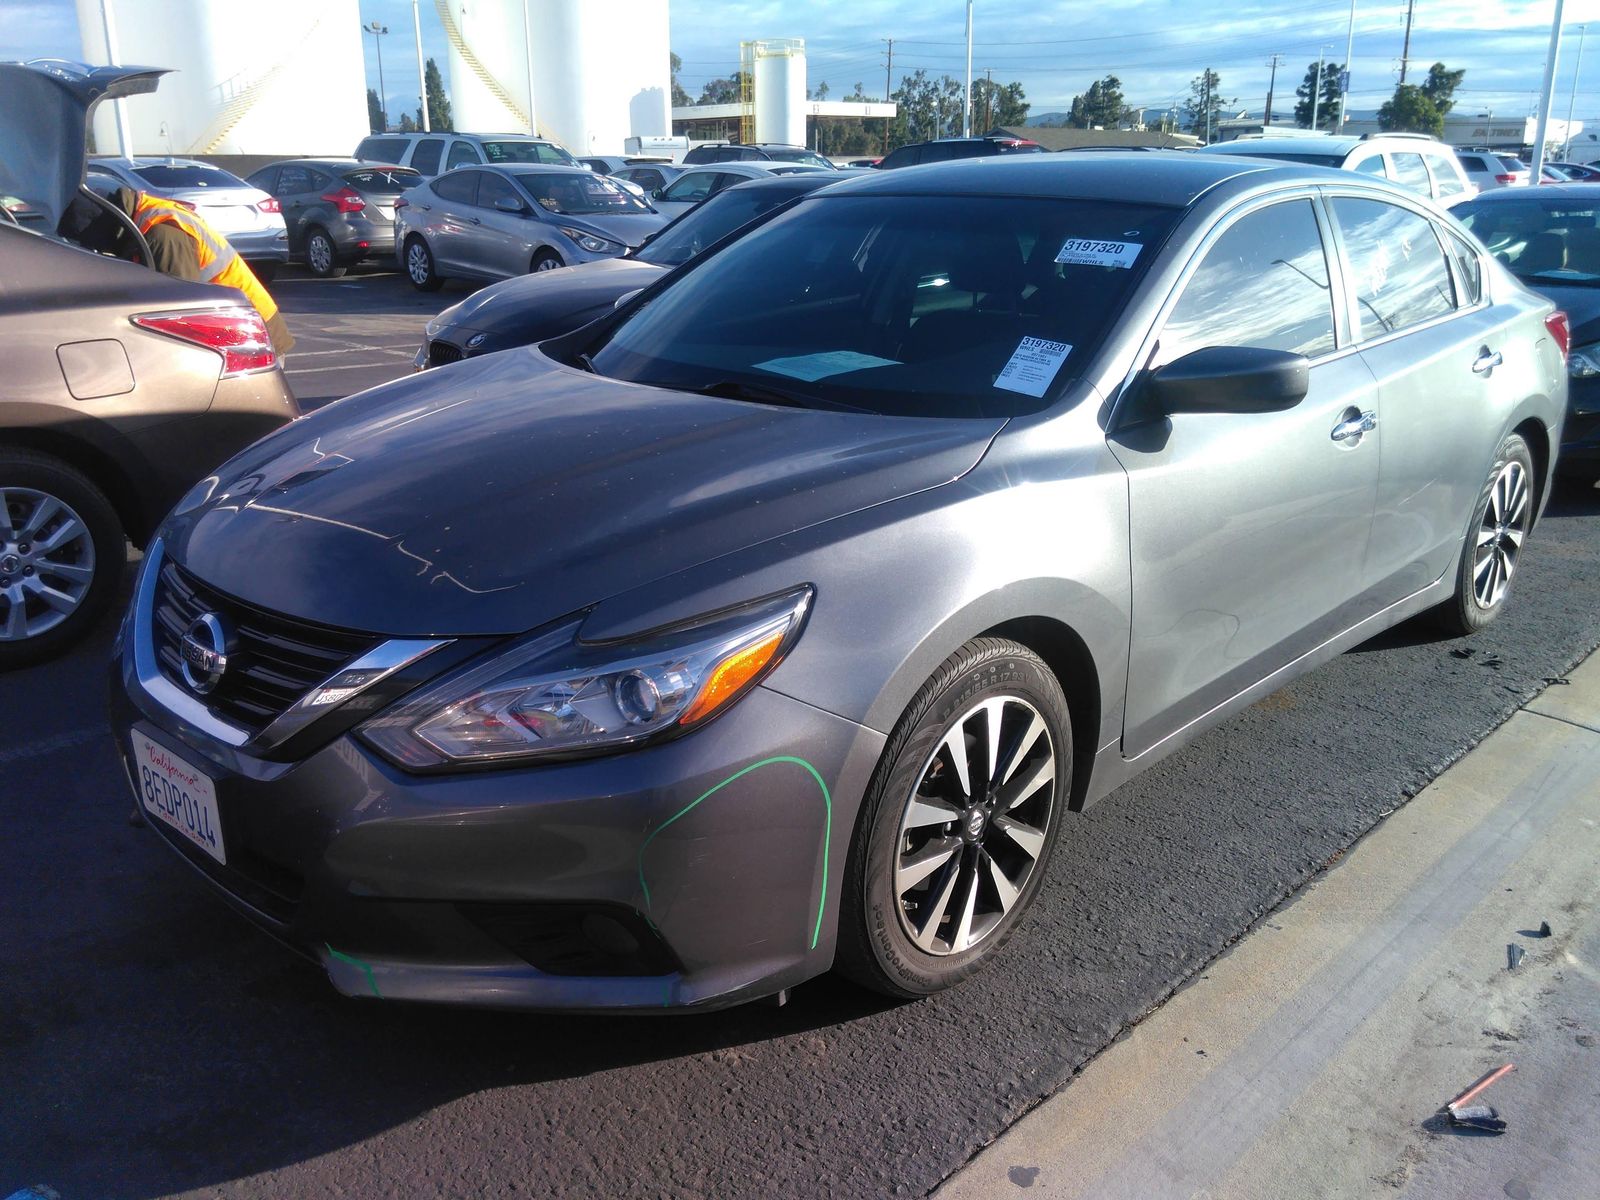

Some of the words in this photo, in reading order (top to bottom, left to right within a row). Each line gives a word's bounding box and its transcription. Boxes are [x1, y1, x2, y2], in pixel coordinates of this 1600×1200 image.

[1064, 240, 1125, 254] 3197320
[1022, 337, 1066, 352] 3197320
[181, 641, 215, 668] ISSAN
[150, 745, 194, 785] California
[142, 765, 216, 849] 8EDP014
